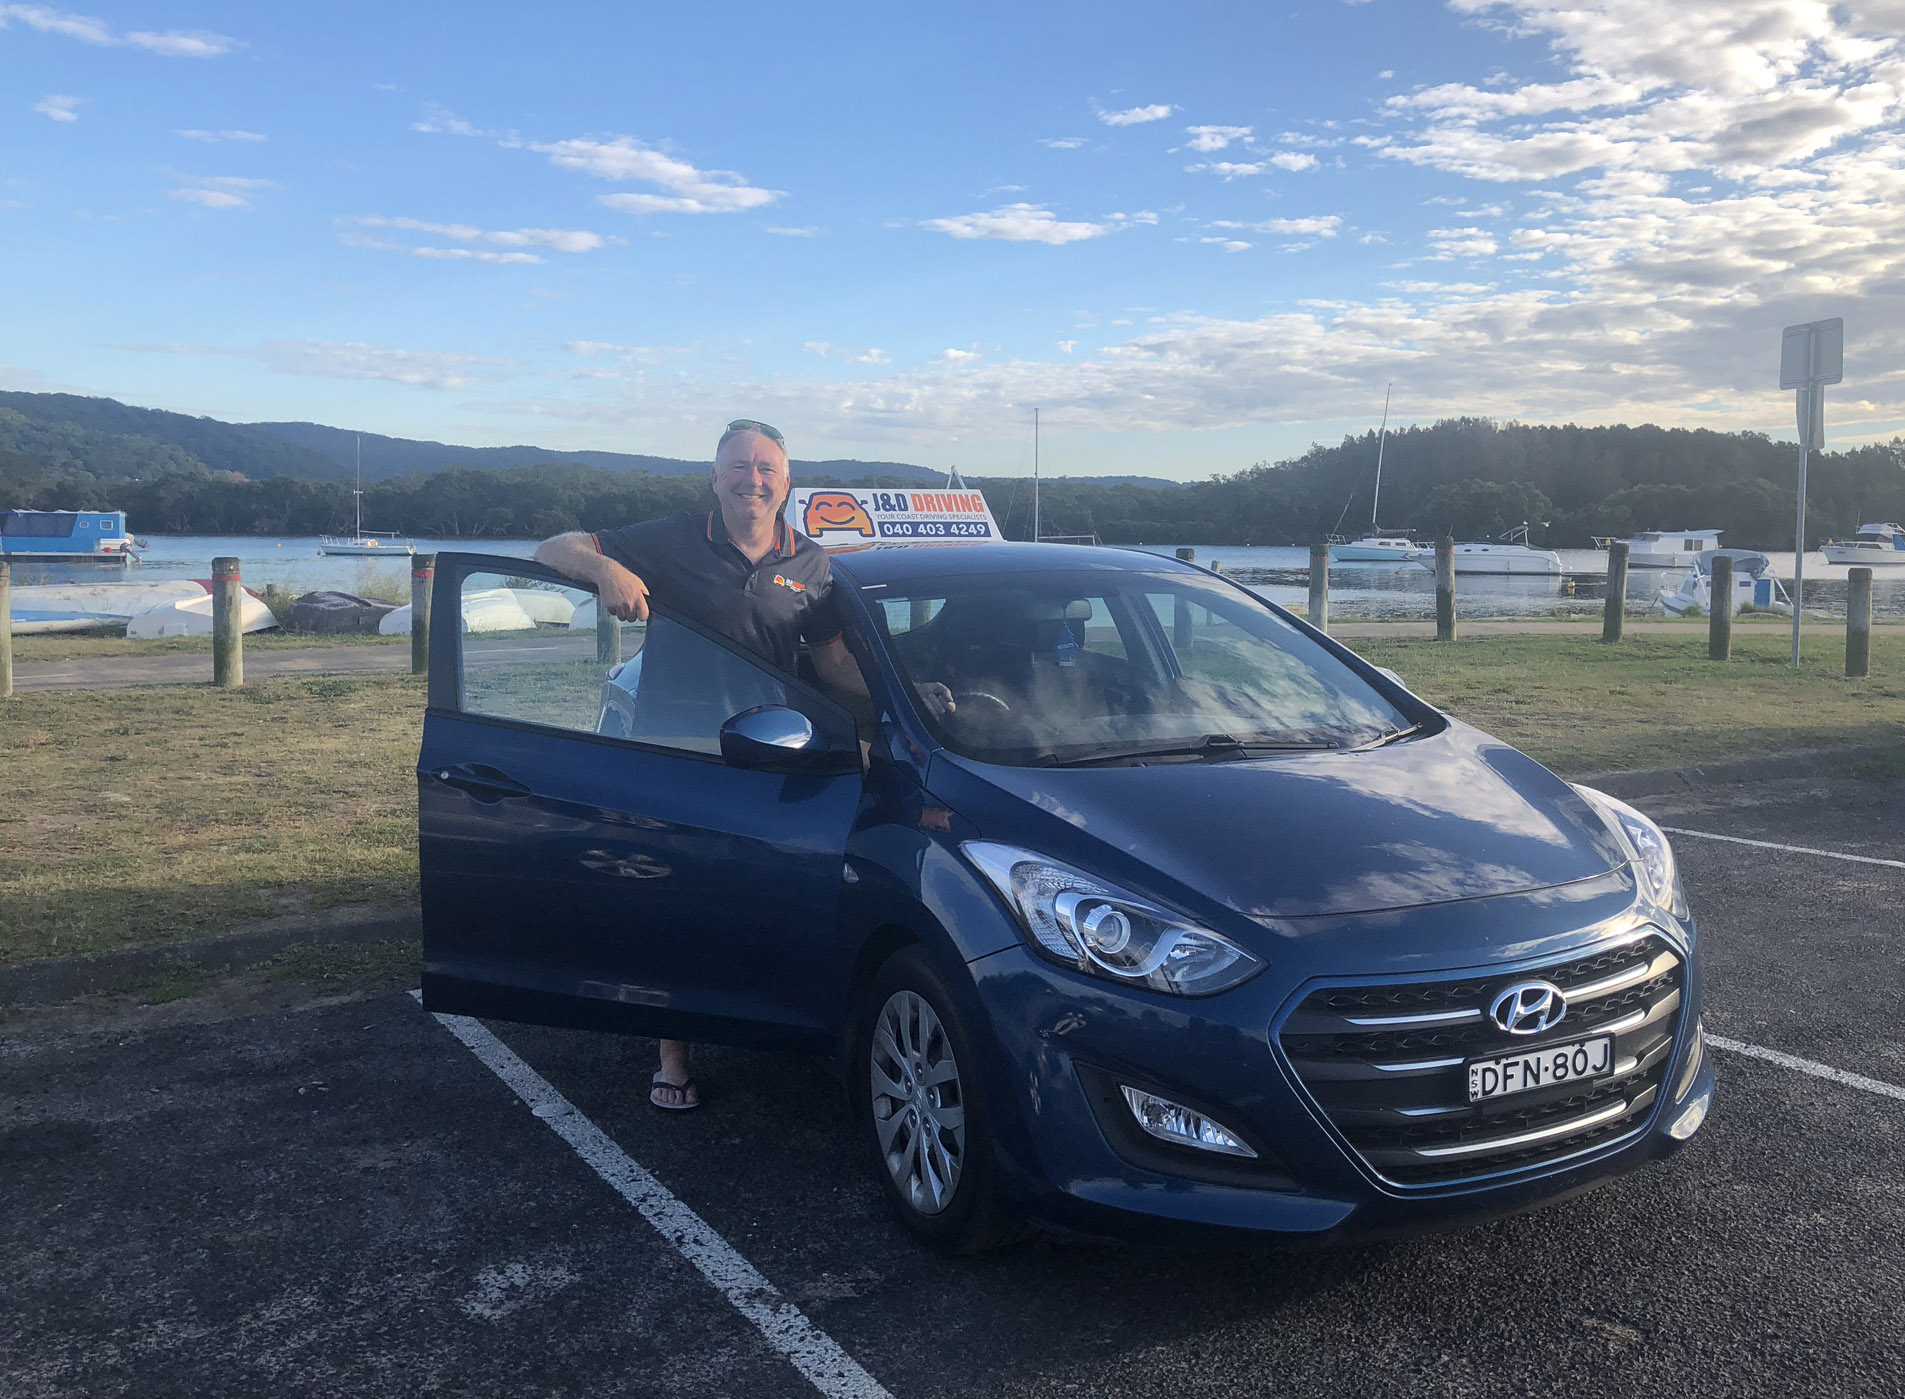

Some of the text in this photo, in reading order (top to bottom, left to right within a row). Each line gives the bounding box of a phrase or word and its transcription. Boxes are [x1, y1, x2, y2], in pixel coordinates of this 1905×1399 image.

[872, 493, 985, 513] J&D DRIVING
[883, 523, 986, 535] 040 403 4249
[1470, 1067, 1480, 1099] NSW
